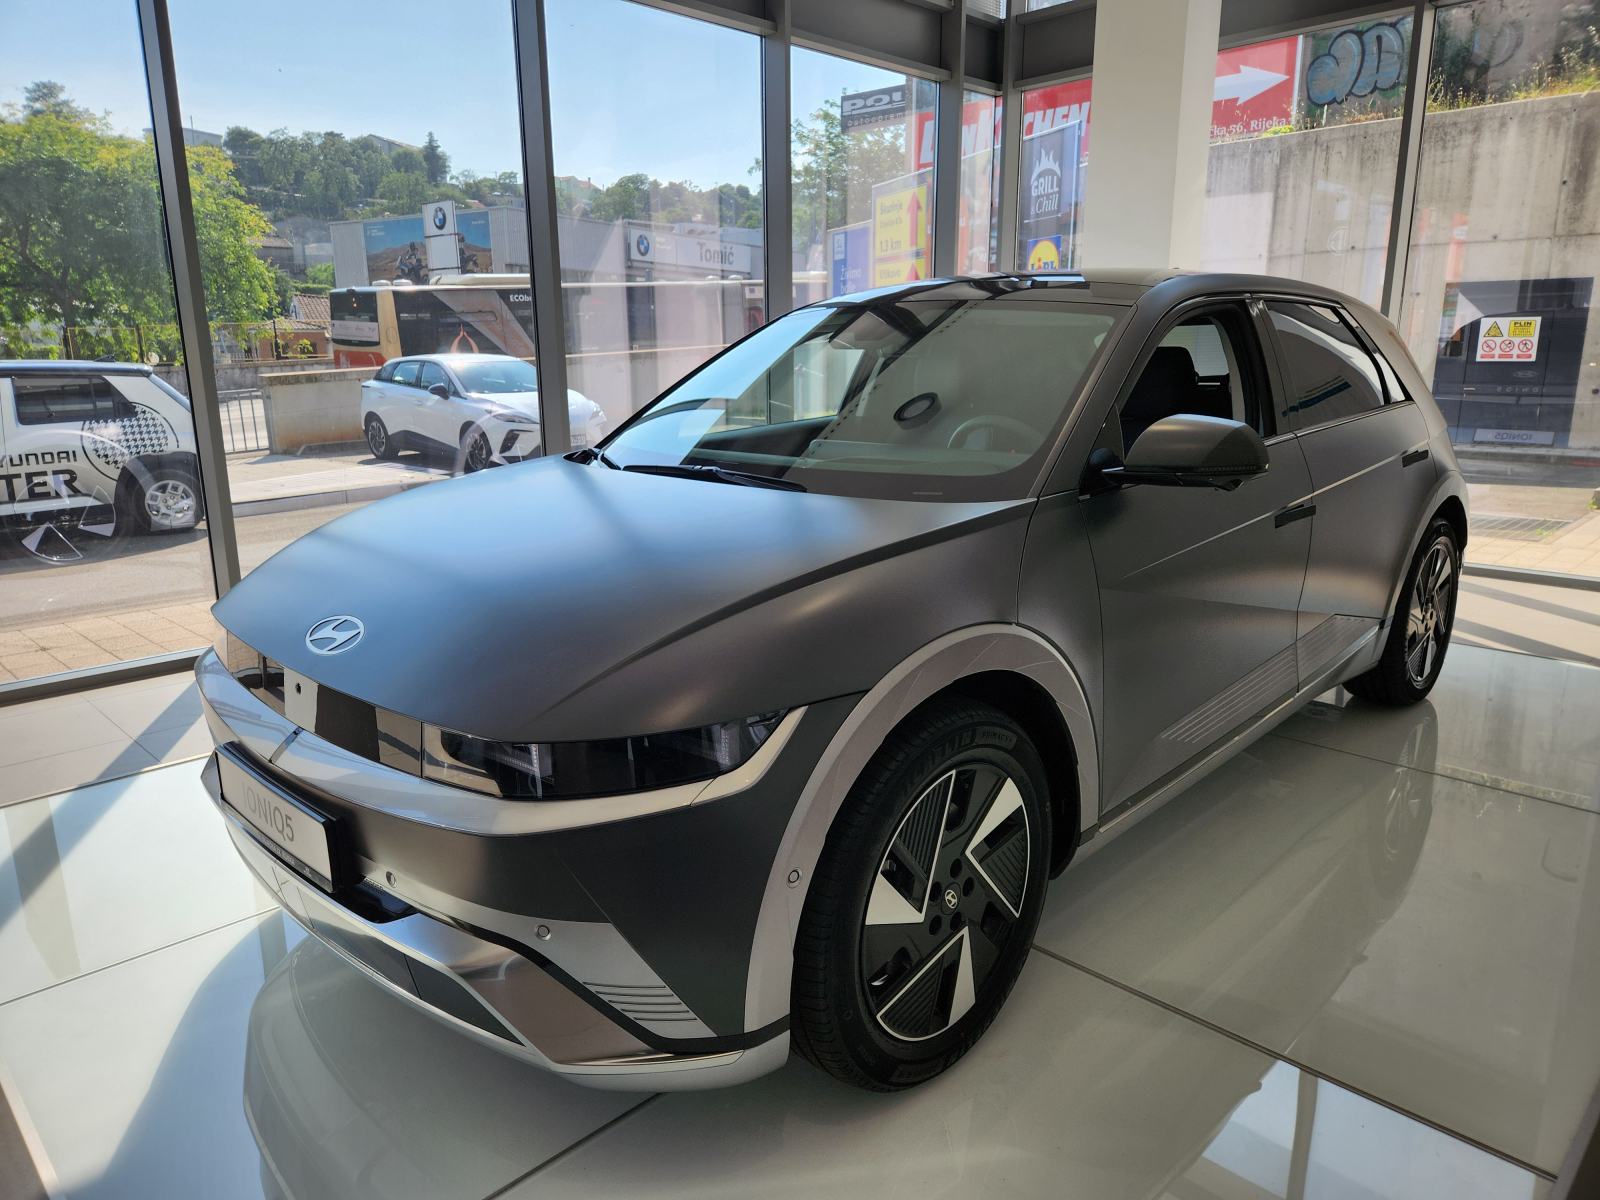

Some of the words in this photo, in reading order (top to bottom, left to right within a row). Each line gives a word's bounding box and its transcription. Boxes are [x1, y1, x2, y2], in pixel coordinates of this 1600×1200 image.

[1250, 116, 1286, 131] Rijeka
[1031, 176, 1059, 196] GRILL
[1035, 194, 1059, 214] Chill
[697, 241, 734, 265] Tomić
[0, 469, 84, 502] TER
